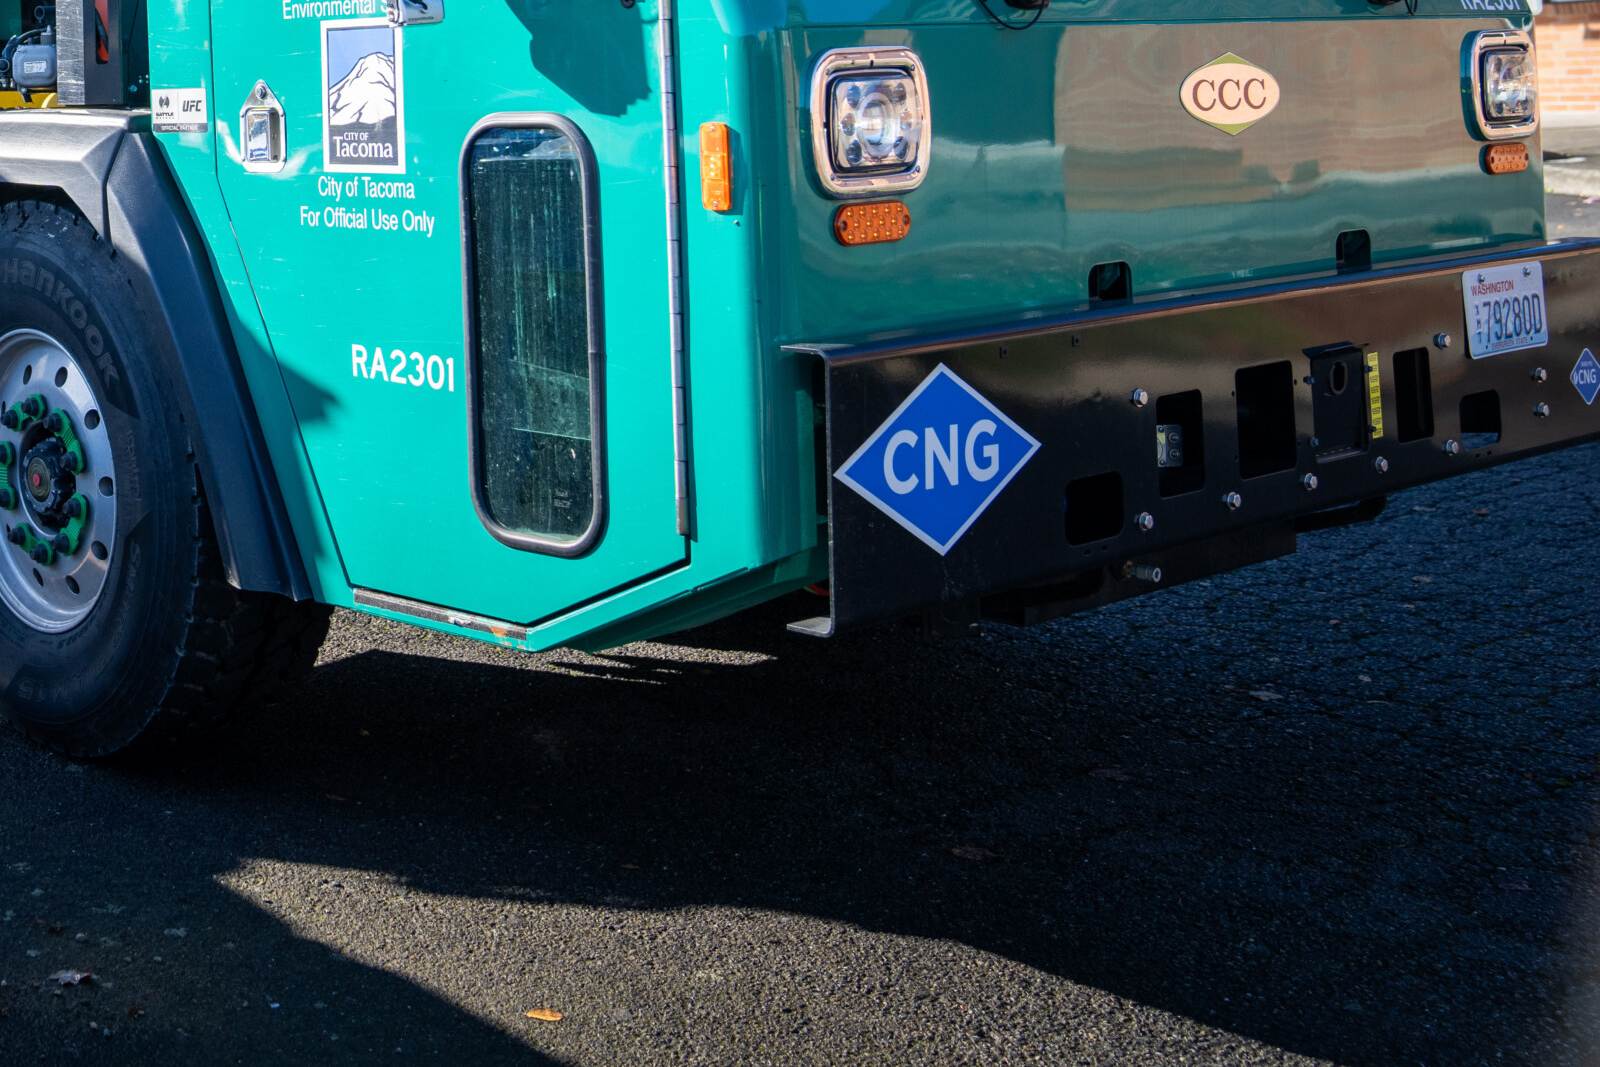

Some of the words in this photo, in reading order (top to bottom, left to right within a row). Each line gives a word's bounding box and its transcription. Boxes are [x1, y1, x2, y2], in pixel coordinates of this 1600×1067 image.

[182, 99, 202, 112] UFC
[1192, 77, 1267, 112] CCC
[333, 136, 394, 159] Tacoma
[343, 132, 359, 141] CITY
[359, 132, 369, 141] OF
[318, 175, 343, 202] City
[345, 176, 359, 197] of
[361, 176, 416, 199] Tacoma
[300, 205, 321, 227] For
[323, 206, 368, 229] Official
[371, 208, 399, 230] Use
[402, 209, 435, 238] Only
[1470, 280, 1514, 296] WASHINGTON
[1482, 292, 1543, 343] 79280D
[1491, 339, 1515, 350] EVERGREEN
[1515, 336, 1529, 345] STATE
[351, 343, 455, 393] RA2301
[1578, 368, 1597, 385] CNG
[883, 418, 1000, 495] CNG
